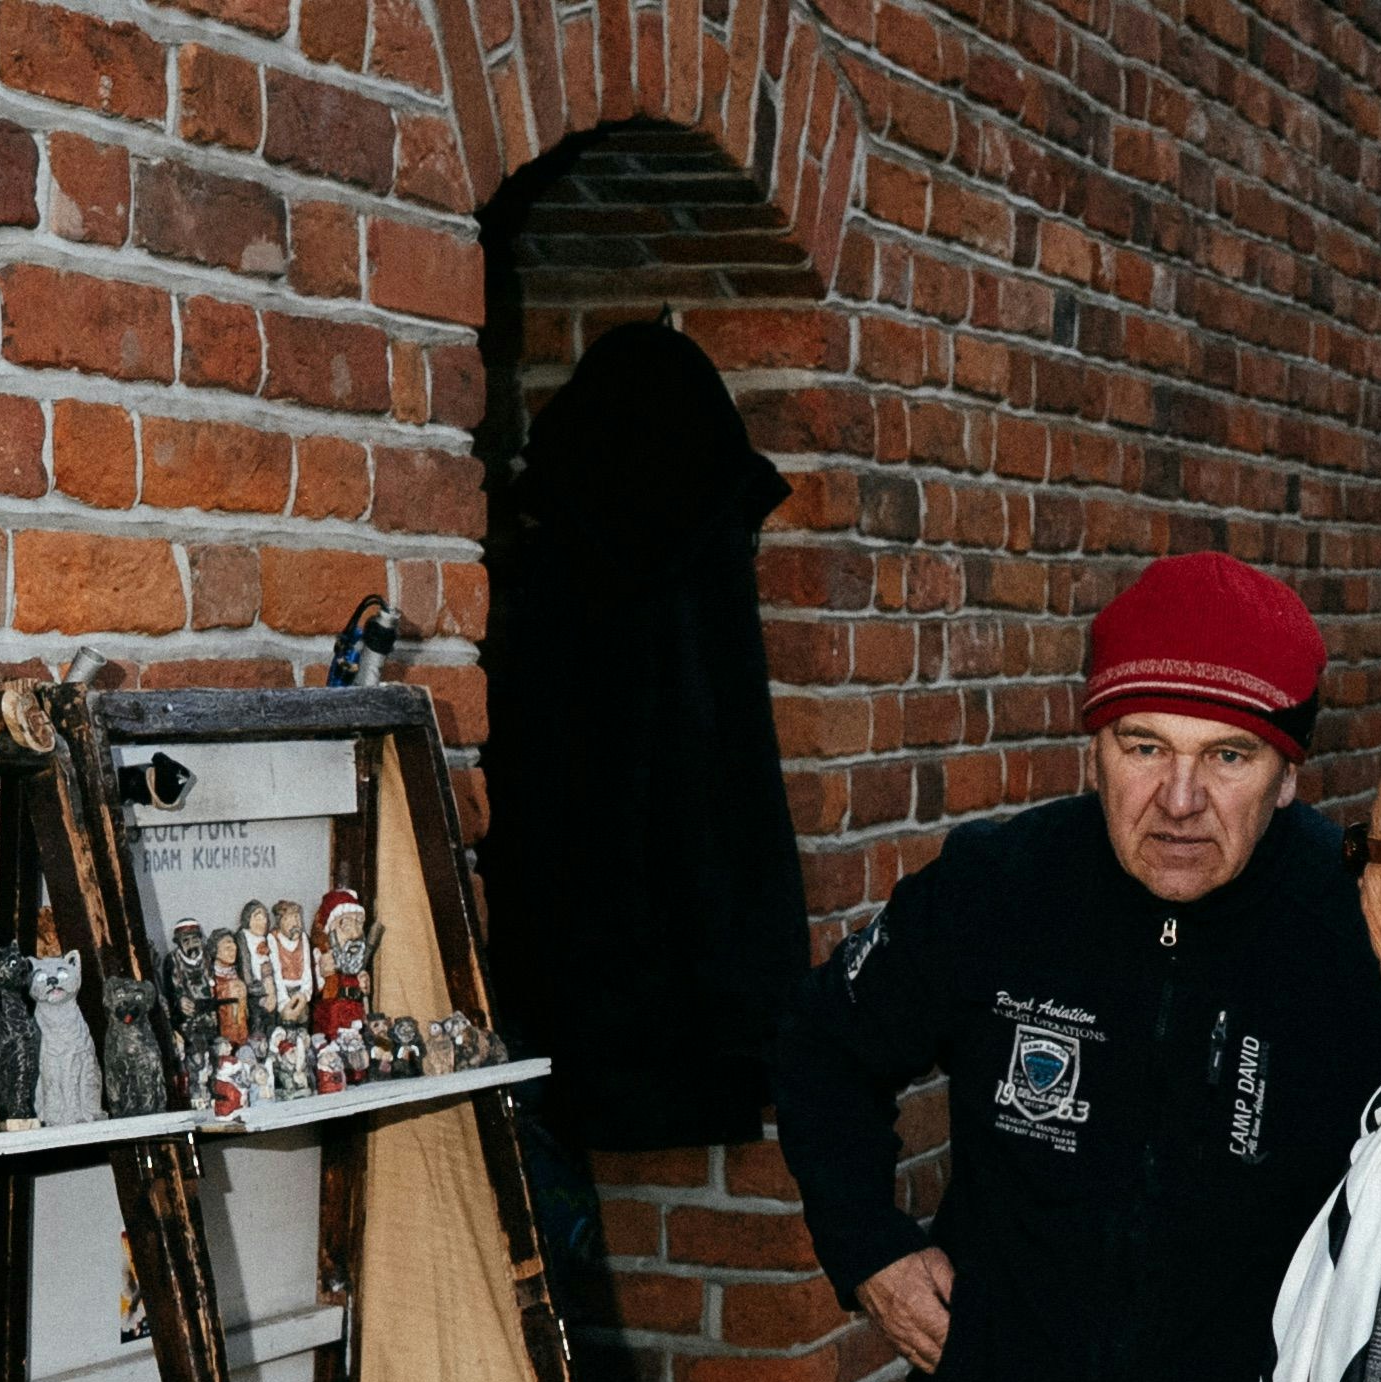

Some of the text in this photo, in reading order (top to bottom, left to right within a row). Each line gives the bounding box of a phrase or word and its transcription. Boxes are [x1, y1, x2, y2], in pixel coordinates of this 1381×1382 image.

[143, 844, 277, 873] ADAM KUCHARSKI
[1036, 997, 1097, 1025] Aviation
[1229, 1034, 1261, 1156] CAMP DAVID
